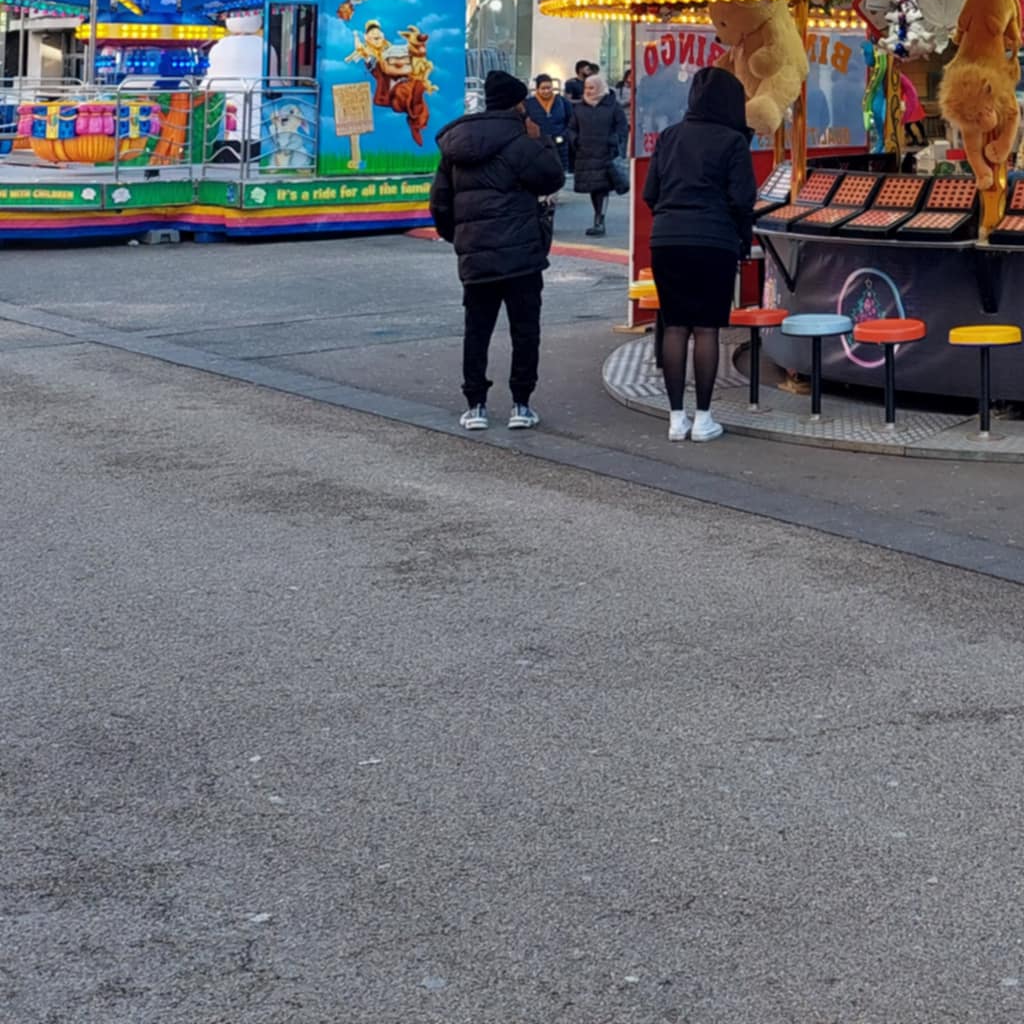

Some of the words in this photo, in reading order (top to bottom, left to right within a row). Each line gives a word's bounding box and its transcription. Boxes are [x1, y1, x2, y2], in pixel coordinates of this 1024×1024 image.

[301, 190, 309, 200] a
[313, 187, 336, 200] ride
[340, 184, 359, 199] for
[361, 183, 376, 196] all
[379, 182, 397, 196] the
[401, 181, 431, 194] famil
